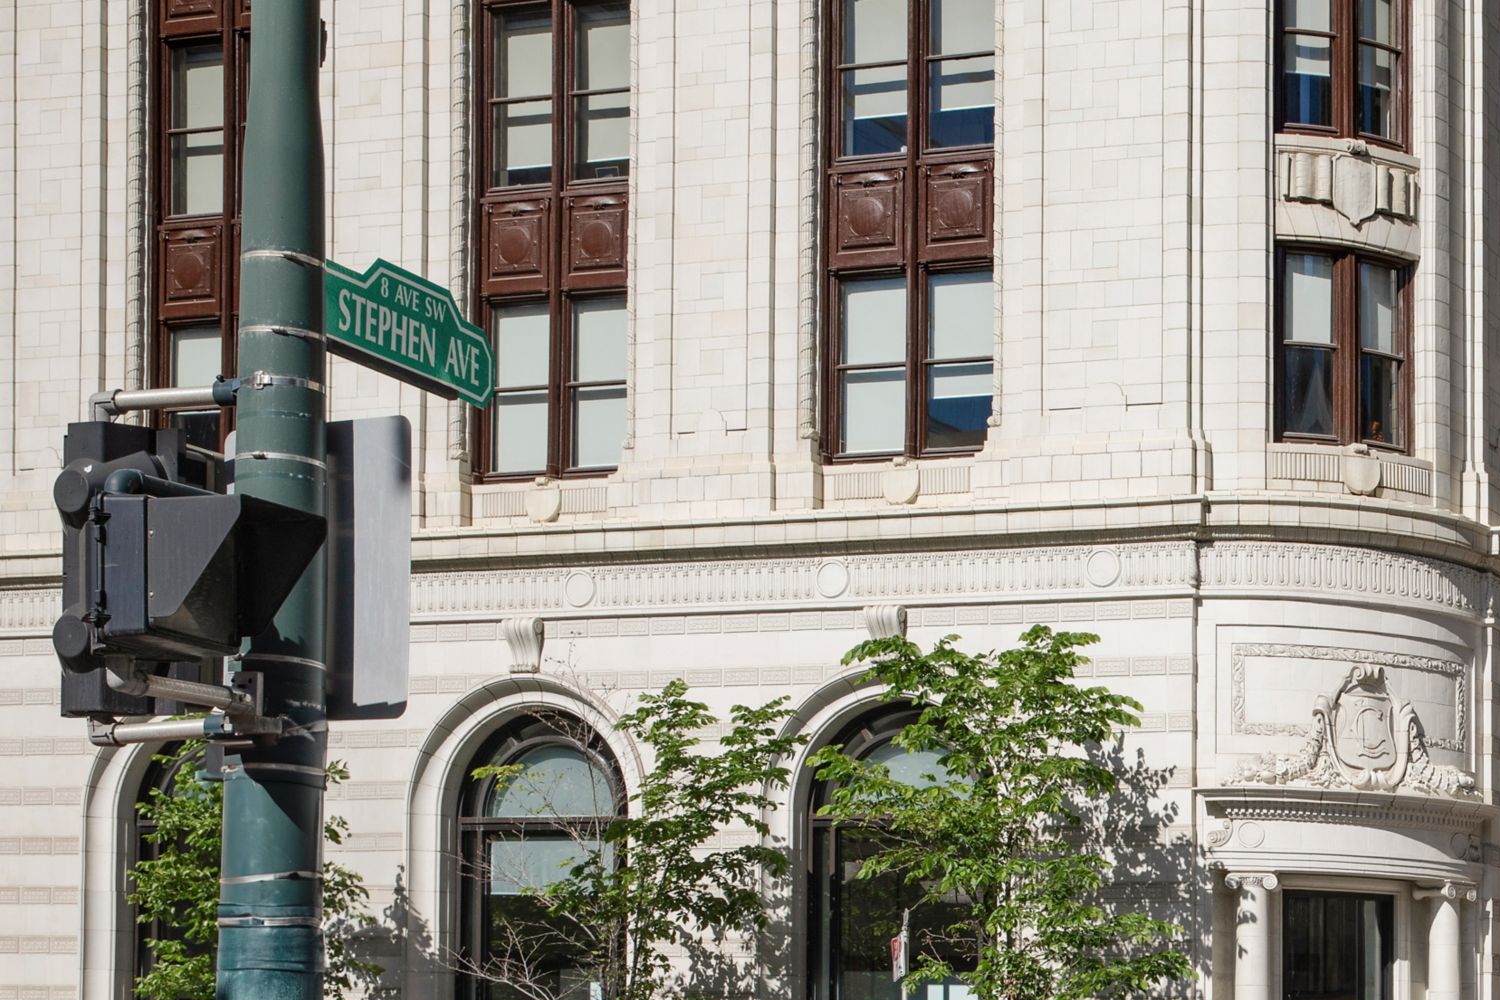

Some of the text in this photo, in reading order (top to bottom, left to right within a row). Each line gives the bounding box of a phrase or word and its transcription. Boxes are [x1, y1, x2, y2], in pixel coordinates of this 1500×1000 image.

[380, 277, 446, 323] 8 AVE SW
[338, 288, 480, 386] STEPHEN AVE
